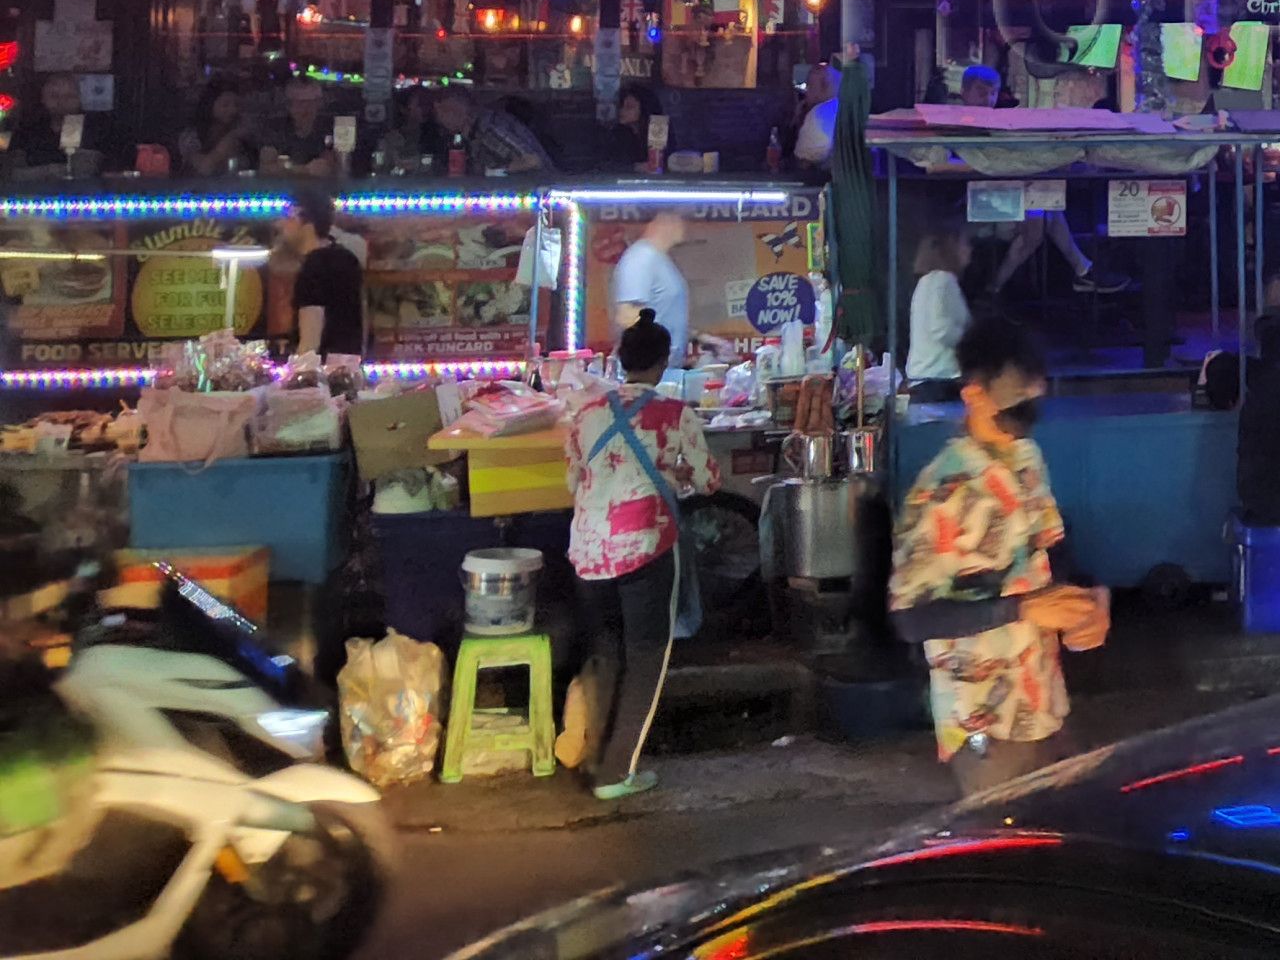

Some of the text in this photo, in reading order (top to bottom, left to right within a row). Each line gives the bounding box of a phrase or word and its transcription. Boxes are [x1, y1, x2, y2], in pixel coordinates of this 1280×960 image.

[1119, 181, 1140, 197] 20
[758, 274, 800, 290] SAVE
[766, 290, 798, 306] 10%
[757, 304, 801, 325] NOW!
[21, 344, 82, 361] FOOD
[427, 341, 494, 353] FUNCARD
